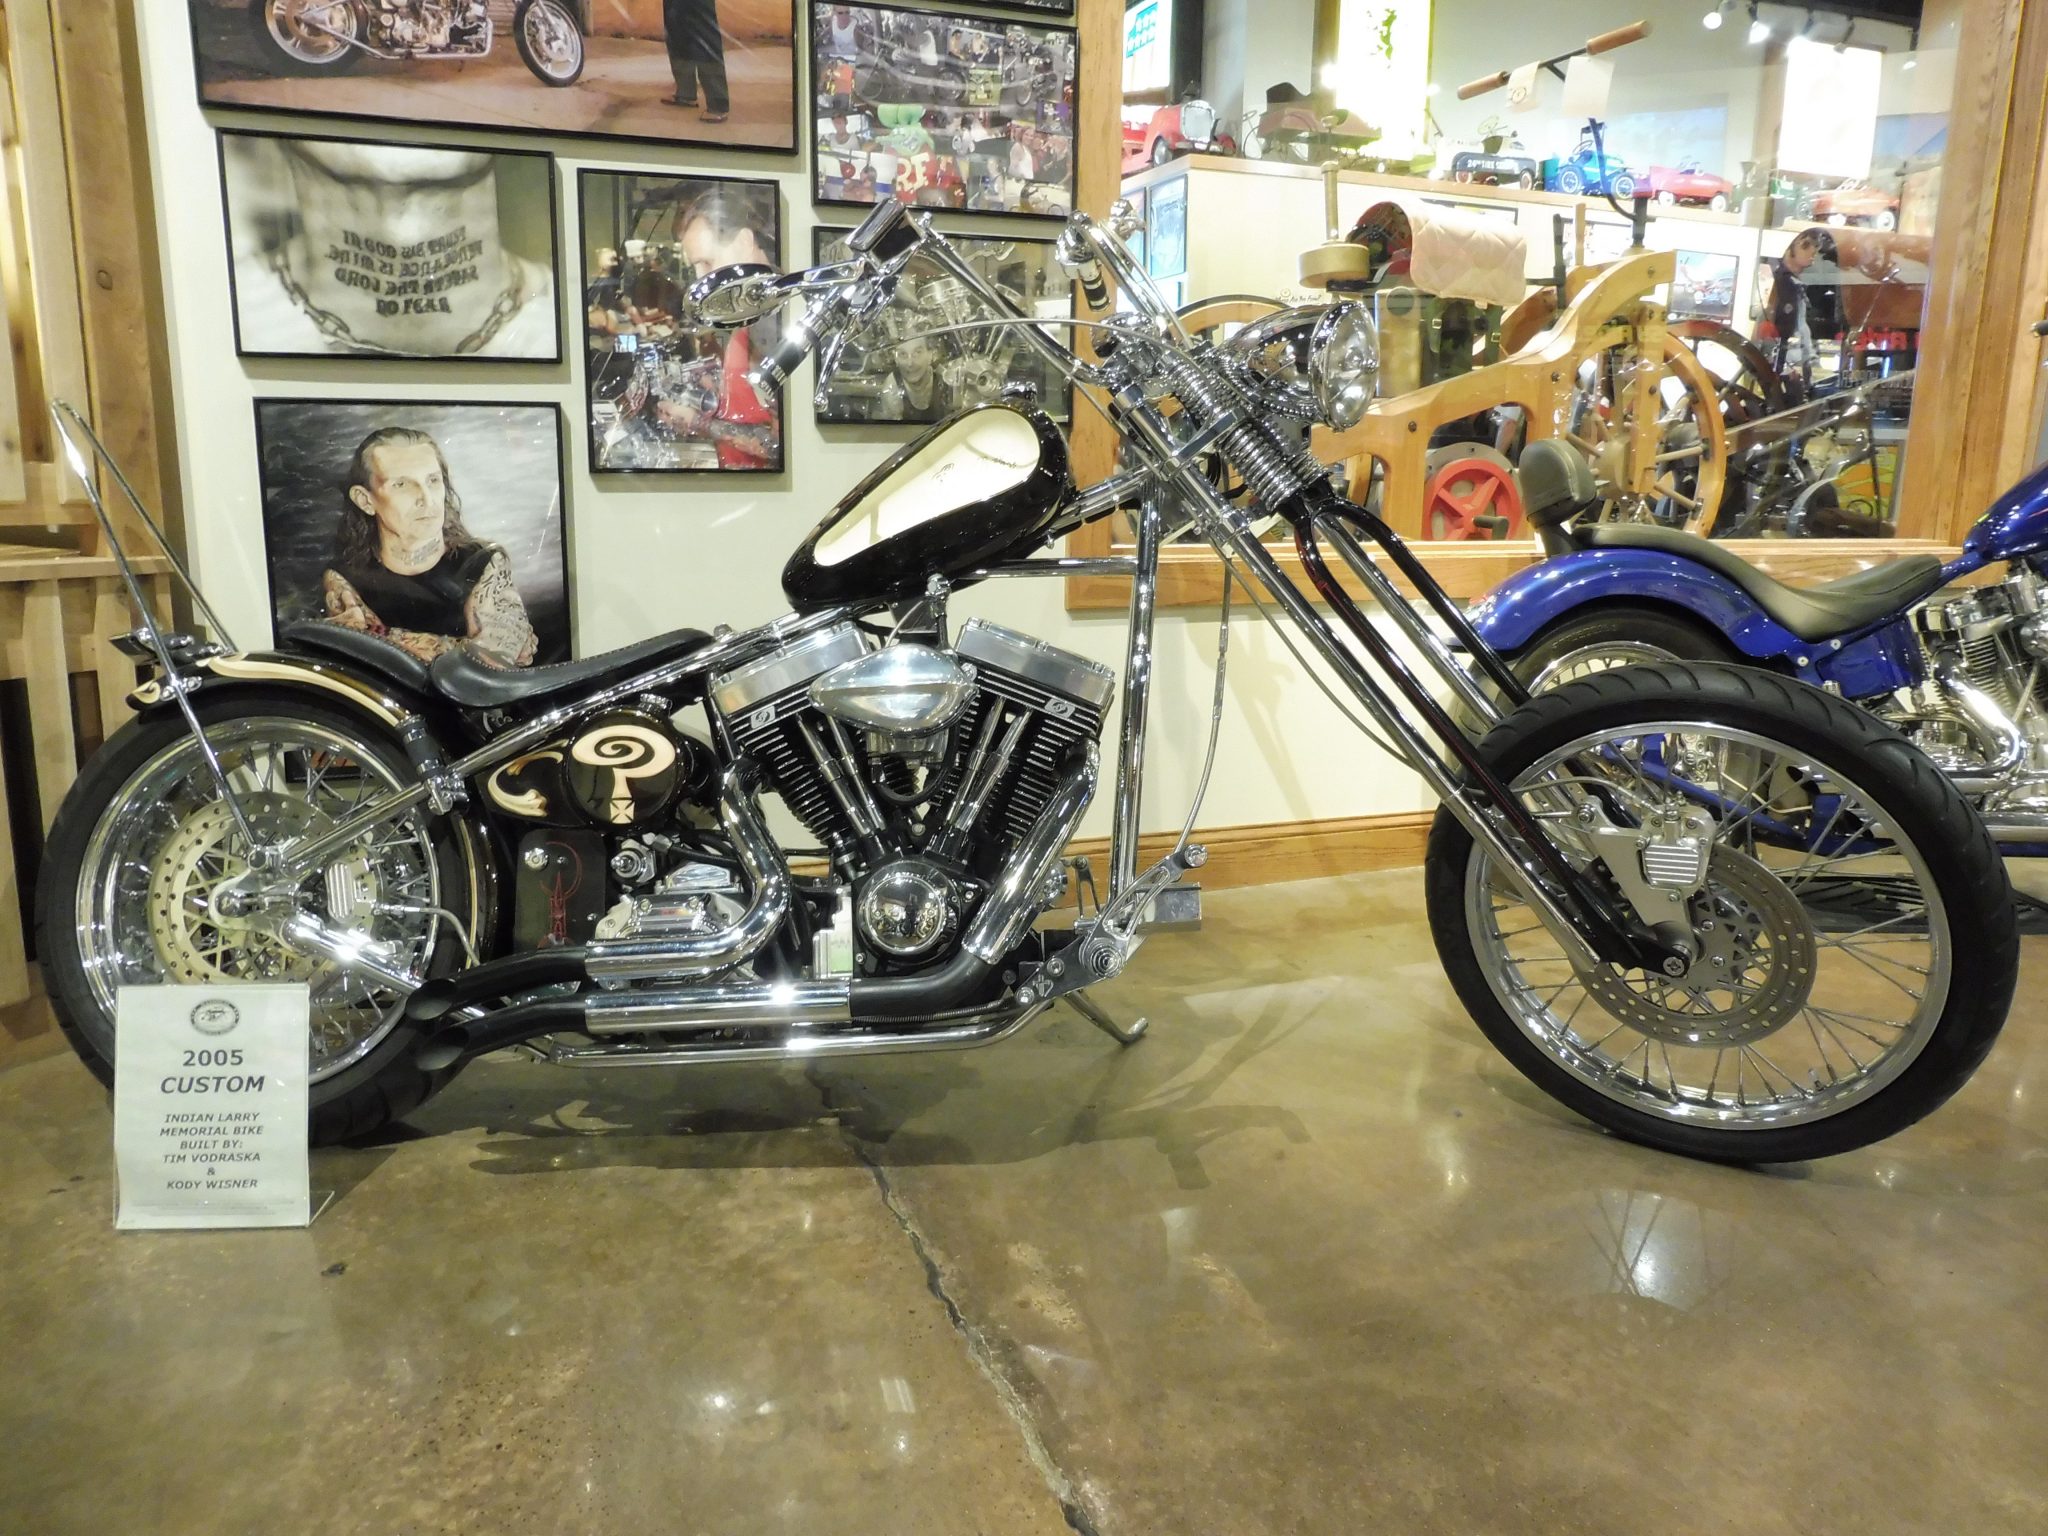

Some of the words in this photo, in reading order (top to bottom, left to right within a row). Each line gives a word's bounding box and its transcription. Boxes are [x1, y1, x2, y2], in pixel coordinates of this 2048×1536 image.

[342, 230, 361, 250] IN
[363, 238, 397, 259] GOD
[375, 297, 399, 317] NO
[403, 297, 452, 315] FEAR
[182, 1049, 244, 1067] 2005
[160, 1075, 265, 1094] CUSTOM
[164, 1113, 214, 1123] INDIAN
[217, 1112, 260, 1122] LARRY
[159, 1126, 228, 1136] MEMORIAL
[232, 1125, 264, 1135] BIKE
[179, 1140, 218, 1150] BUILT
[222, 1139, 244, 1149] BY:
[163, 1154, 188, 1164] TIM
[191, 1153, 261, 1163] VODRASKA
[206, 1167, 216, 1176] &
[166, 1180, 201, 1189] KODY
[205, 1179, 258, 1189] WISNER
